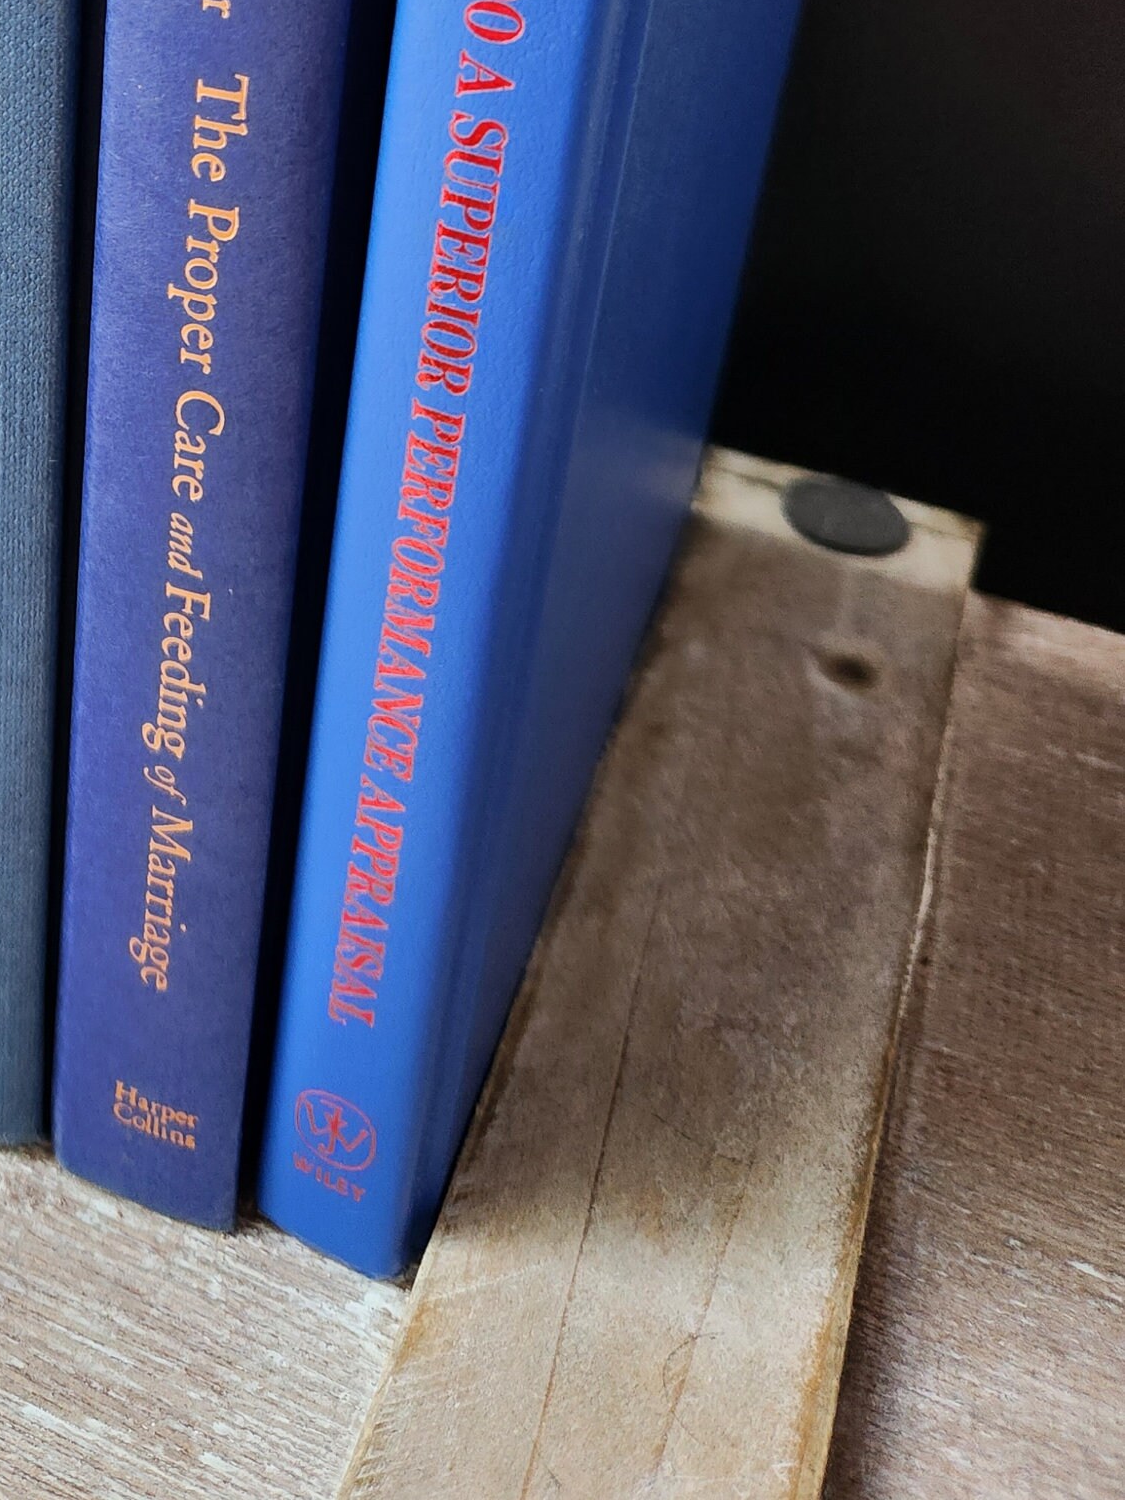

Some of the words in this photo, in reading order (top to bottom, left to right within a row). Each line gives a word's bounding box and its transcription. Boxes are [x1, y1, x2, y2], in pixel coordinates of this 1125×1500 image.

[191, 74, 250, 182] The
[455, 50, 516, 97] A
[168, 199, 239, 375] Proper
[415, 111, 510, 396] SUPERIOR
[172, 390, 225, 502] Care
[168, 512, 203, 579] and
[364, 397, 467, 781] PERFORMANCE
[141, 581, 211, 759] Feeding
[143, 765, 187, 806] of
[130, 805, 194, 992] Marriage
[328, 771, 406, 1028] APPRAISAL
[113, 1102, 196, 1149] Collins
[115, 1080, 199, 1128] Harper
